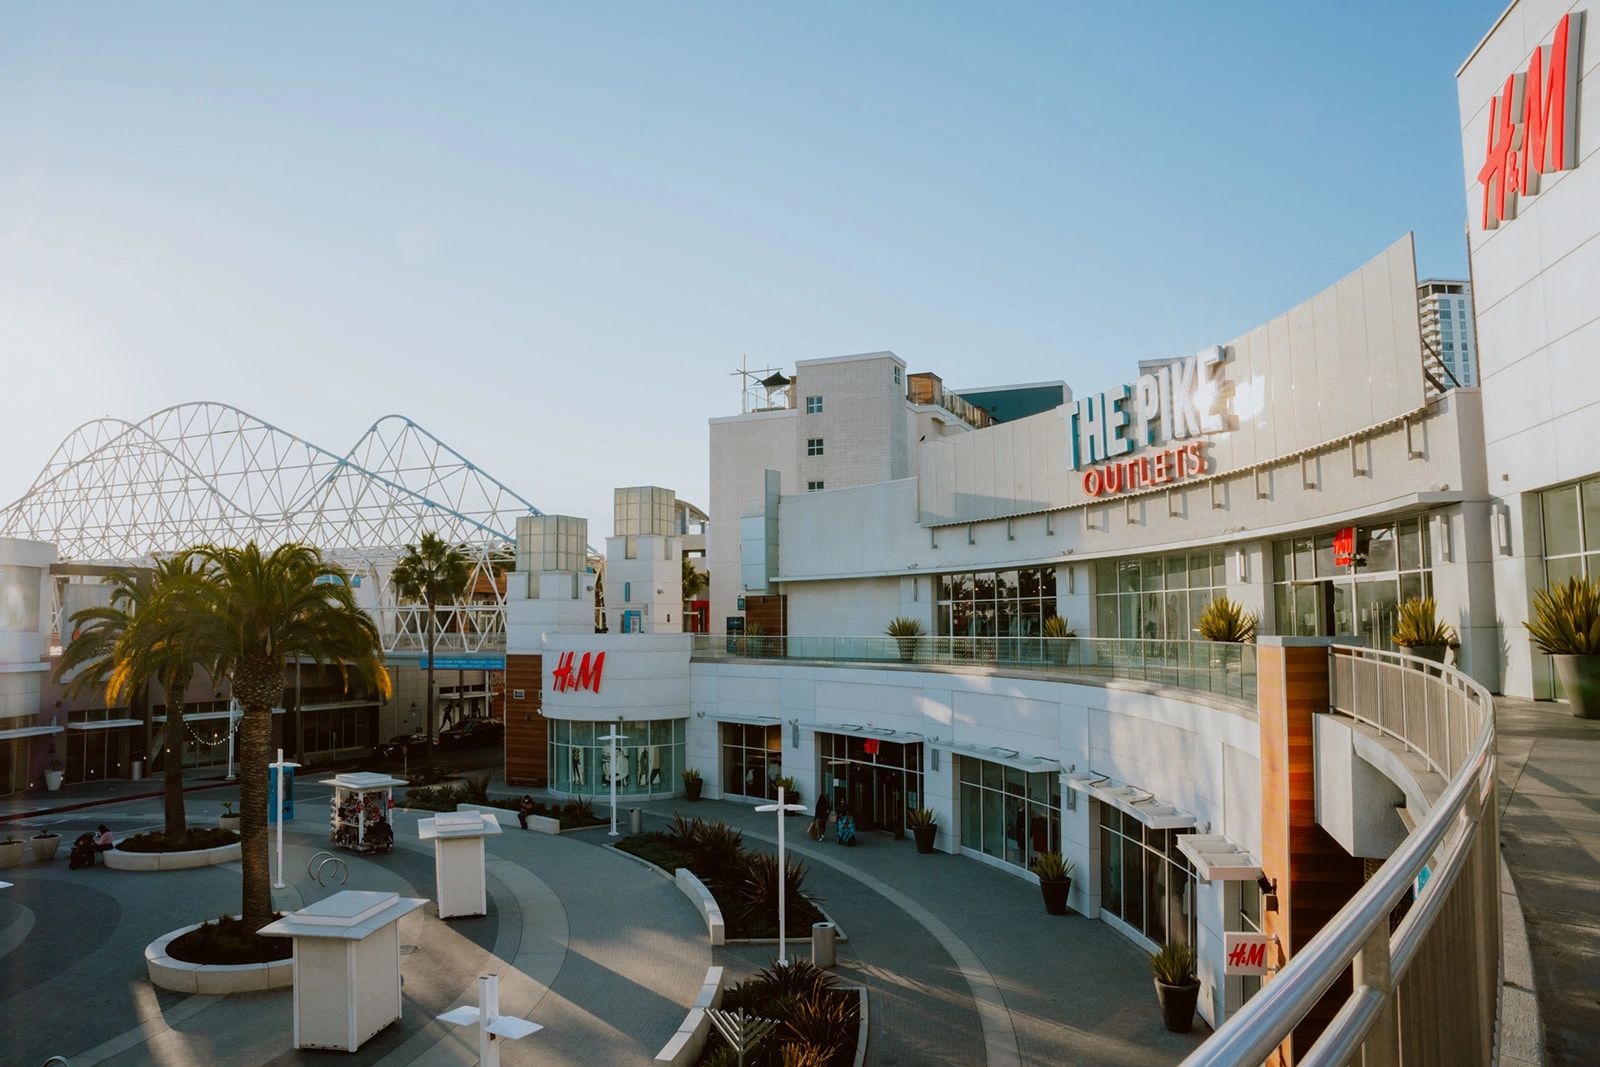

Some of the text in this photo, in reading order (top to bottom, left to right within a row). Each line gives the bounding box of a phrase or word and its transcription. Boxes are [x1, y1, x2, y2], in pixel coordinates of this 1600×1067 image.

[1477, 11, 1576, 231] H&M
[1056, 345, 1229, 471] THE PIKE
[1082, 441, 1208, 497] OUTLETS
[552, 651, 606, 694] H&M
[1228, 943, 1266, 968] H&M
